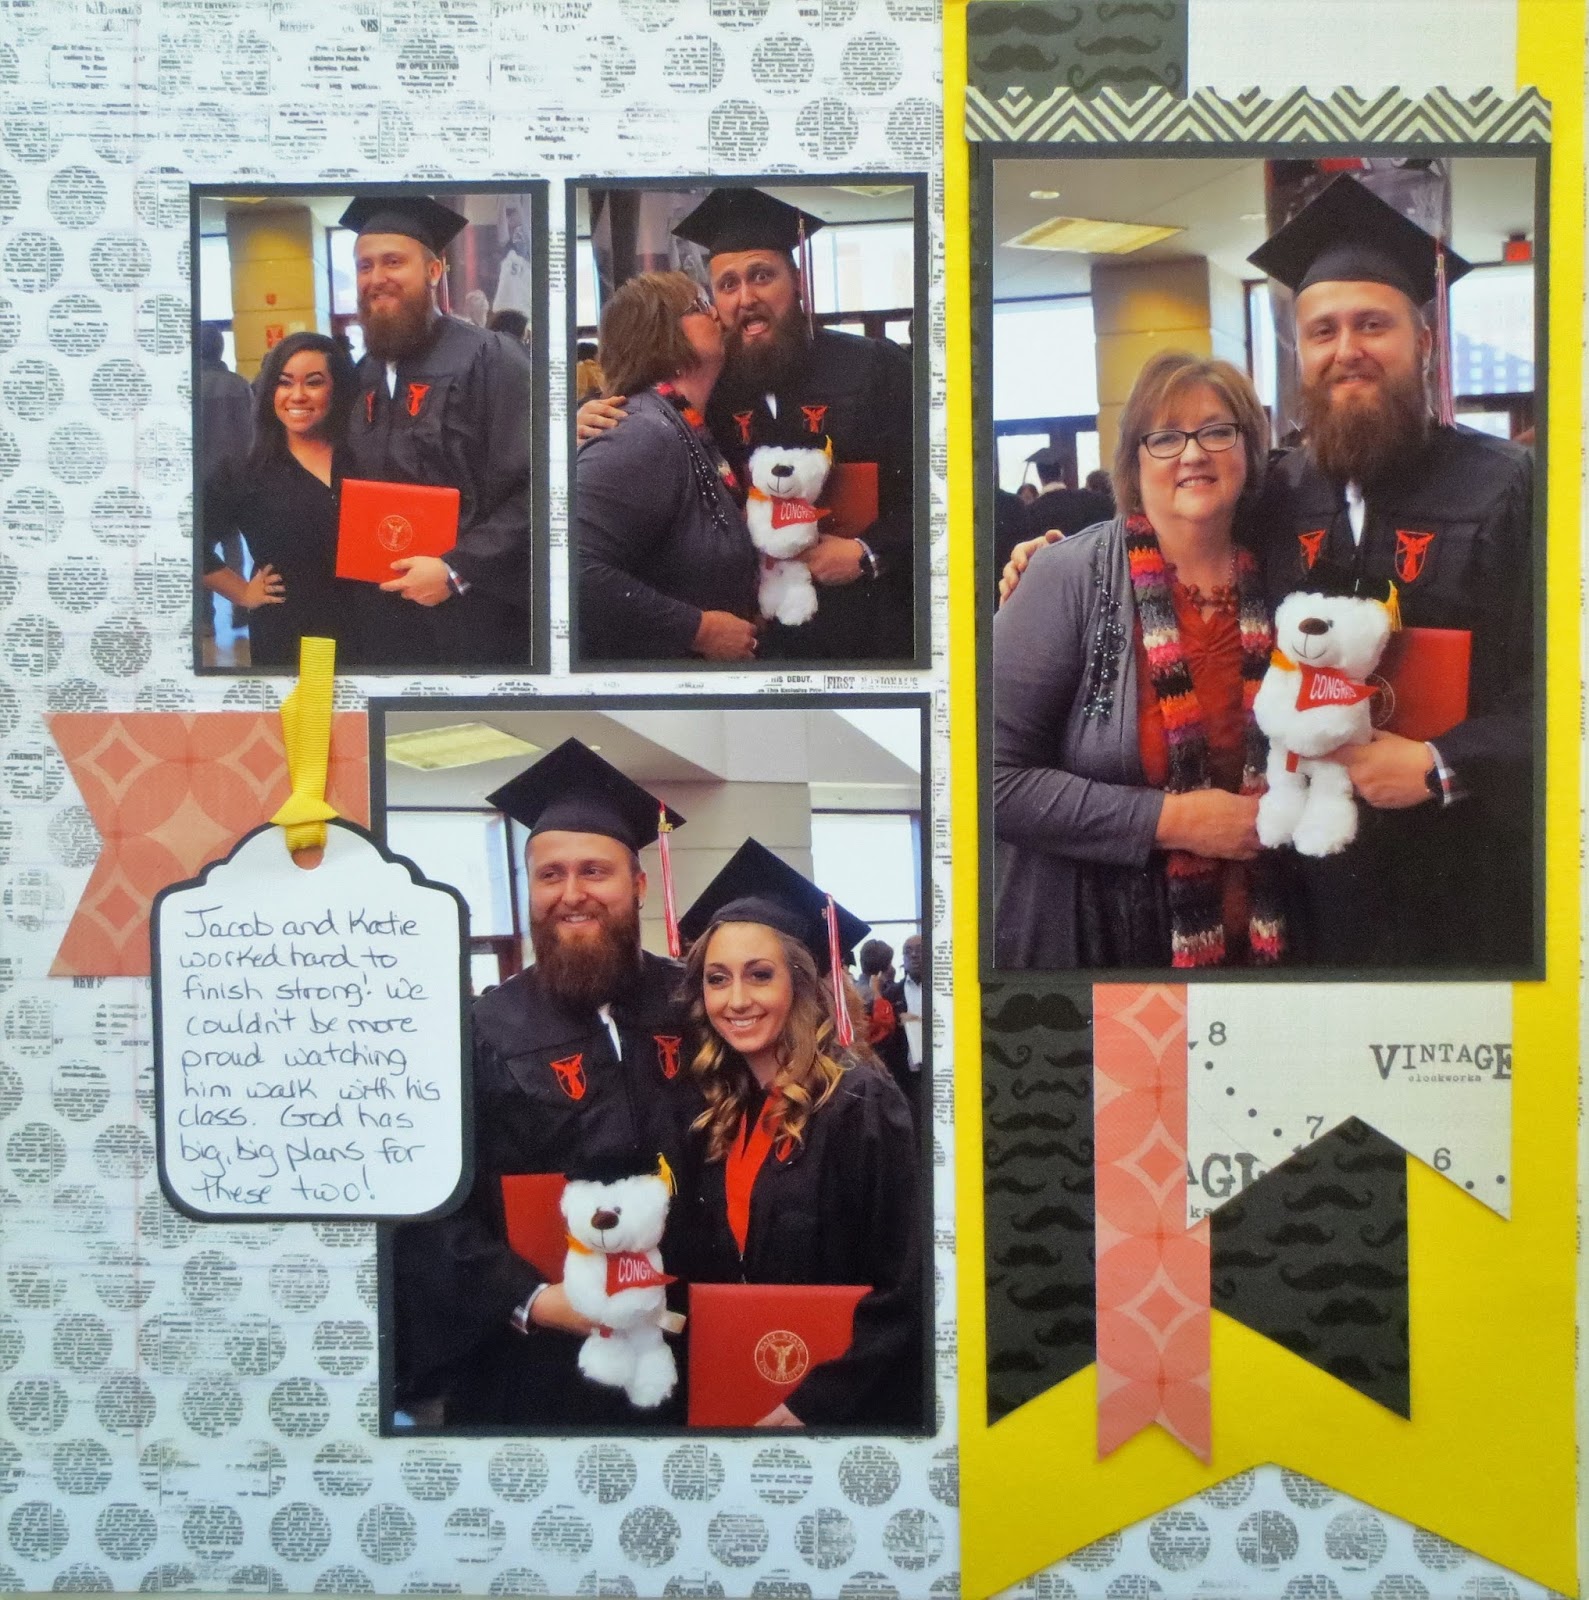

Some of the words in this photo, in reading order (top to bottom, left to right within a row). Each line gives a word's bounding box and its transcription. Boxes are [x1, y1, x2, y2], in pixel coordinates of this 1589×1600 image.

[184, 905, 275, 938] Jacob
[282, 908, 339, 937] and
[349, 907, 421, 936] Katie
[179, 943, 287, 969] worked
[290, 941, 360, 969] hard
[361, 946, 398, 968] to
[182, 973, 263, 1000] finish
[275, 971, 372, 1007] strong!
[309, 1007, 343, 1035] be
[347, 1015, 419, 1035] more
[1208, 1020, 1228, 1046] 8
[181, 1041, 265, 1075] proud
[284, 1040, 408, 1076] watching
[1368, 1042, 1513, 1080] VINTAGE
[184, 1077, 232, 1098] him
[246, 1077, 318, 1099] walk
[339, 1076, 396, 1101] with
[405, 1077, 441, 1101] his
[178, 1103, 257, 1128] class.
[280, 1103, 344, 1128] God
[358, 1104, 415, 1129] has
[1306, 1115, 1325, 1140] 7
[286, 1135, 366, 1172] plans
[374, 1137, 427, 1164] for
[1433, 1147, 1452, 1172] 6
[290, 1163, 377, 1202] two!
